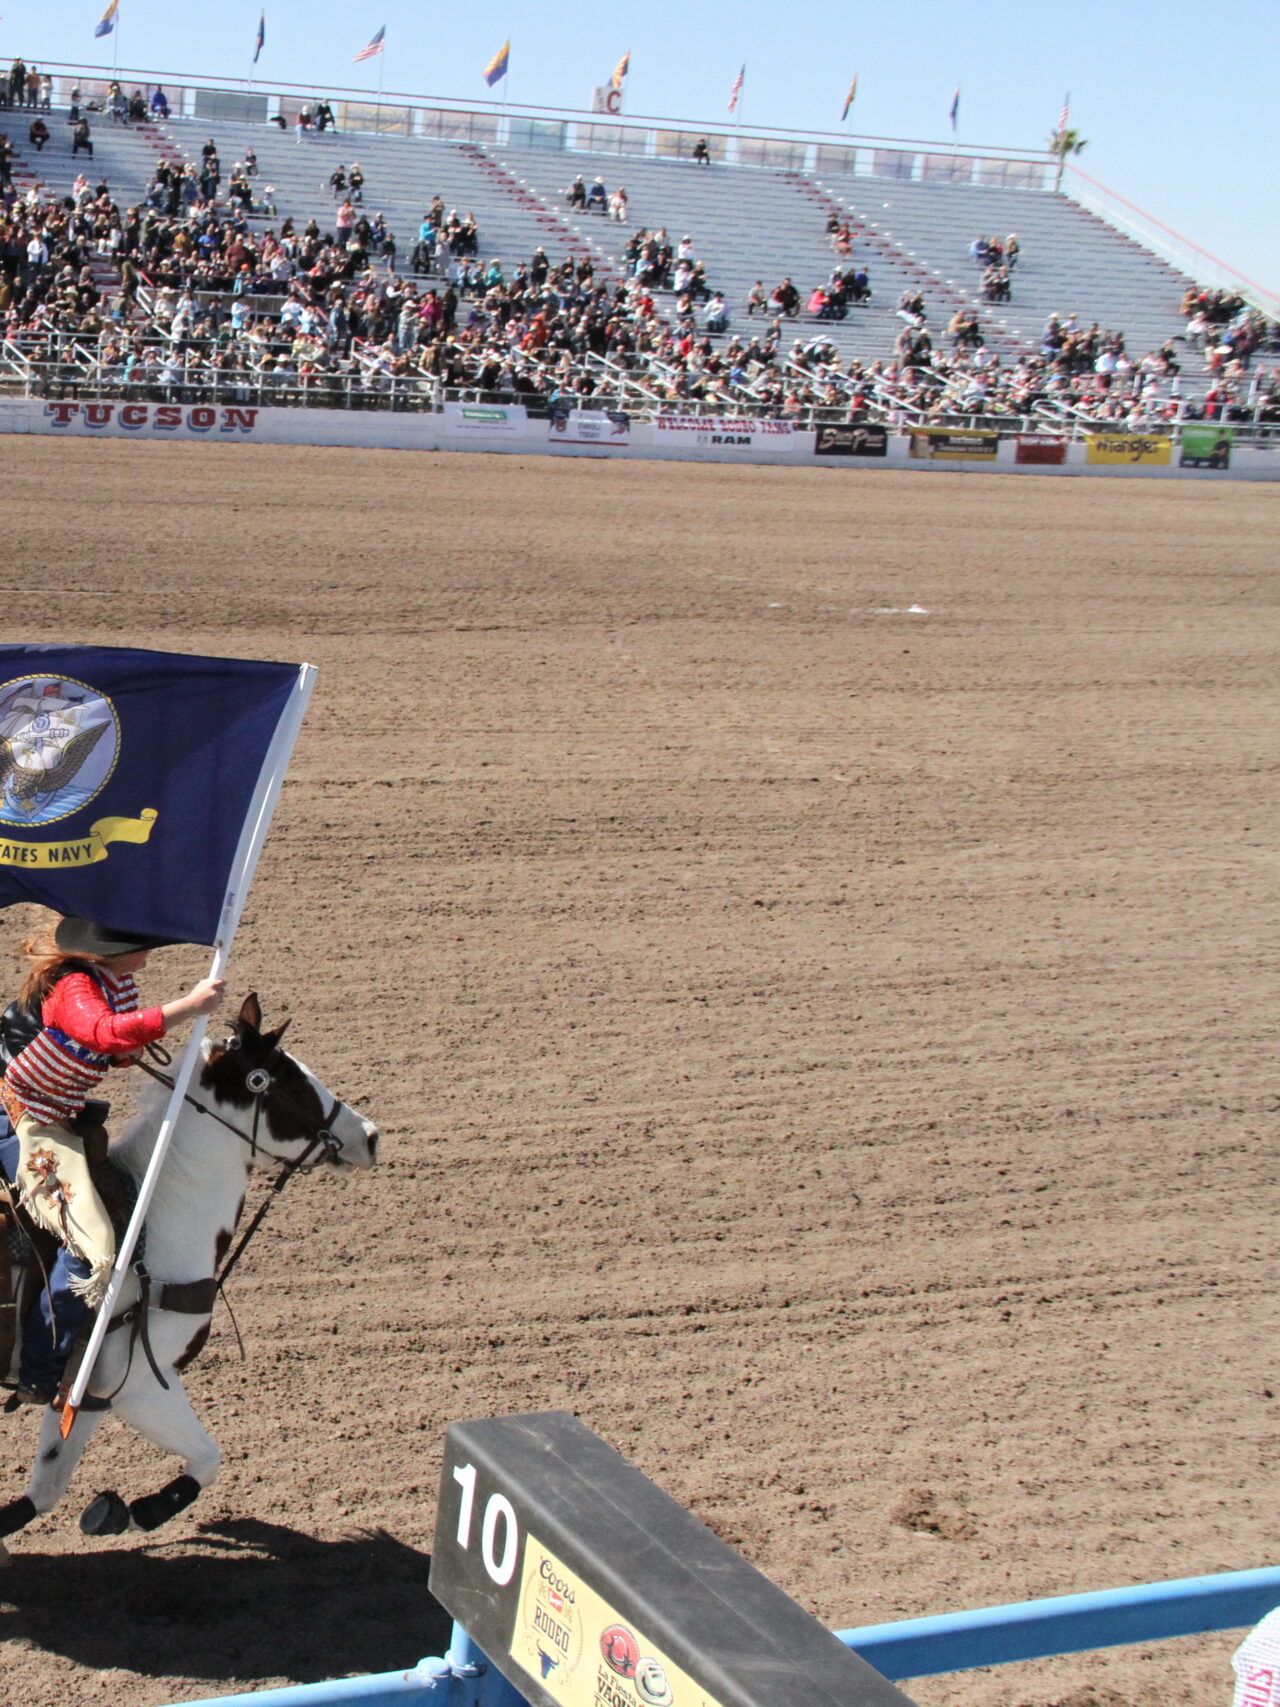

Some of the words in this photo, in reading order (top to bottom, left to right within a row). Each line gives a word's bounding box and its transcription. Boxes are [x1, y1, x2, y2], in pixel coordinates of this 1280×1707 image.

[44, 402, 258, 433] TUCSON
[654, 416, 716, 431] WELCOME
[720, 419, 756, 433] RODEO
[711, 435, 751, 445] RAM
[48, 843, 93, 863] NAVY
[453, 1463, 518, 1586] 10
[540, 1556, 575, 1604] Coors
[534, 1605, 570, 1653] RODEO
